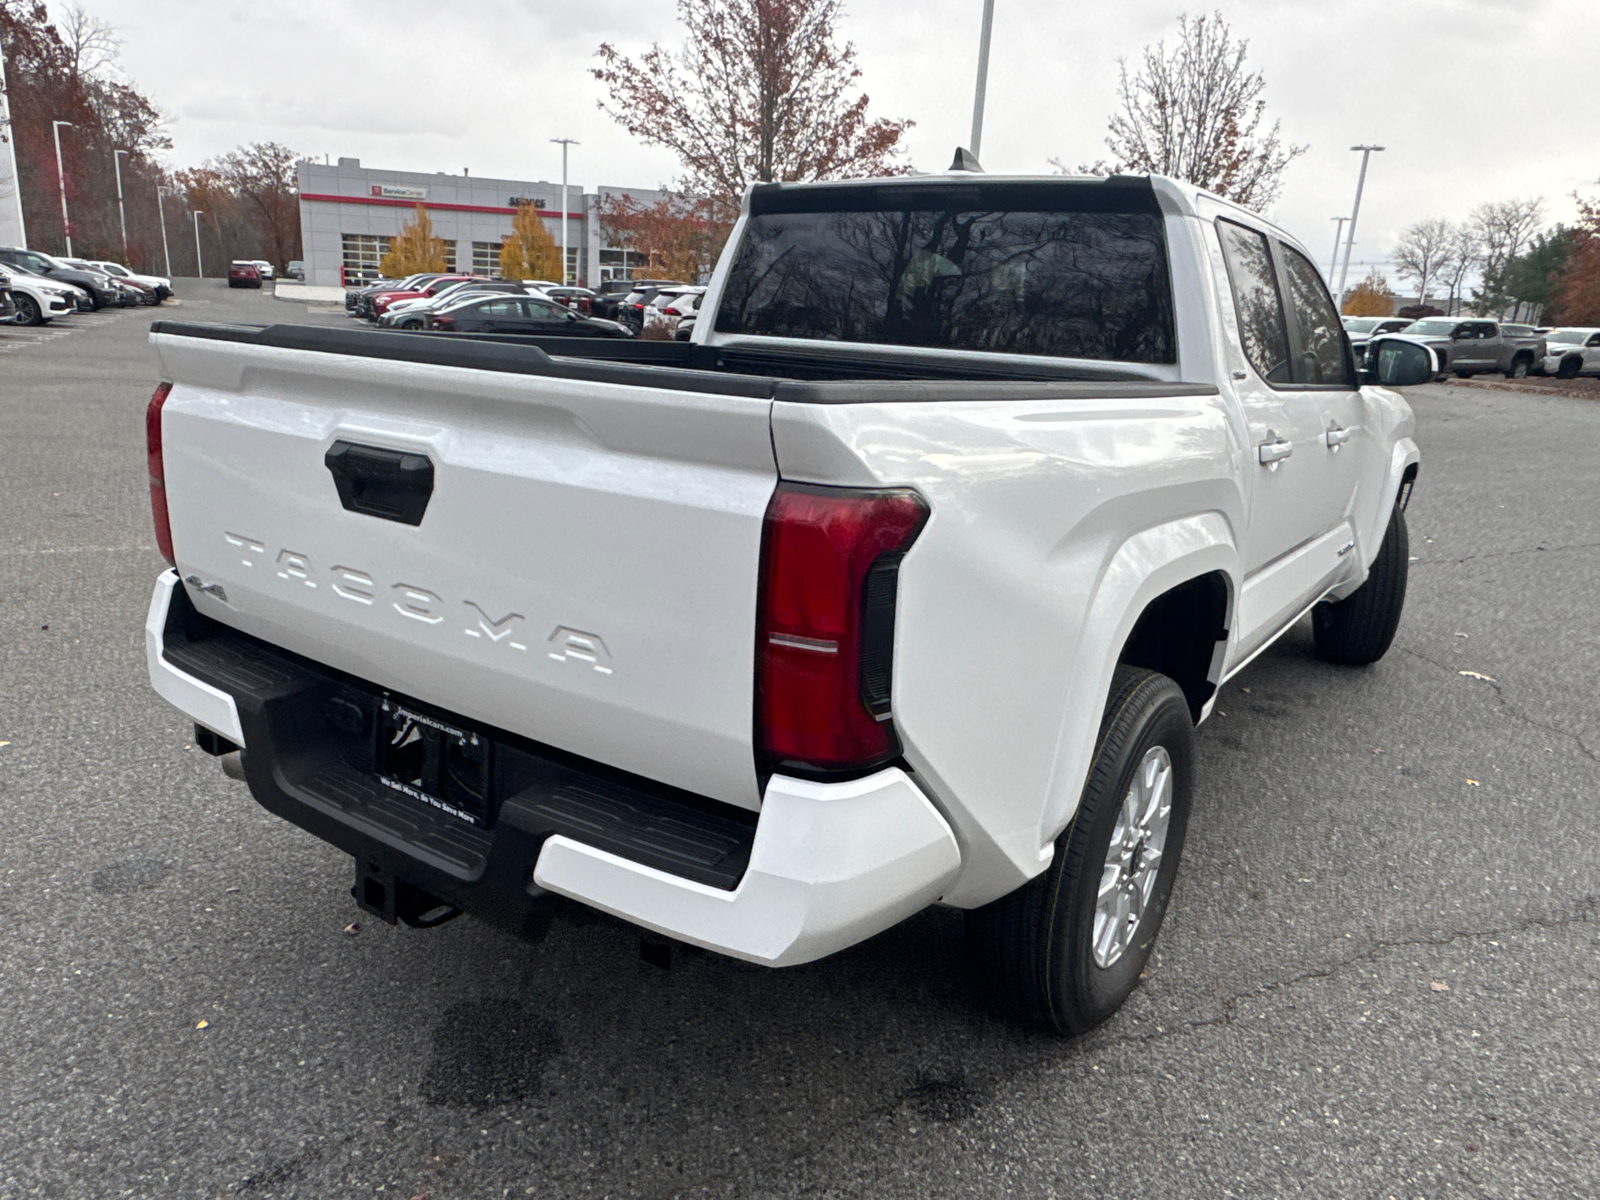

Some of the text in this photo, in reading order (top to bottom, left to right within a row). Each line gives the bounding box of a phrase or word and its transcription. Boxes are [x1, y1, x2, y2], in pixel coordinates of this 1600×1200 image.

[225, 531, 613, 675] TACOMA
[380, 777, 391, 787] We
[390, 781, 402, 791] Sell
[420, 793, 429, 803] So
[429, 797, 441, 809] You
[441, 802, 457, 816] Save
[457, 810, 475, 824] More
